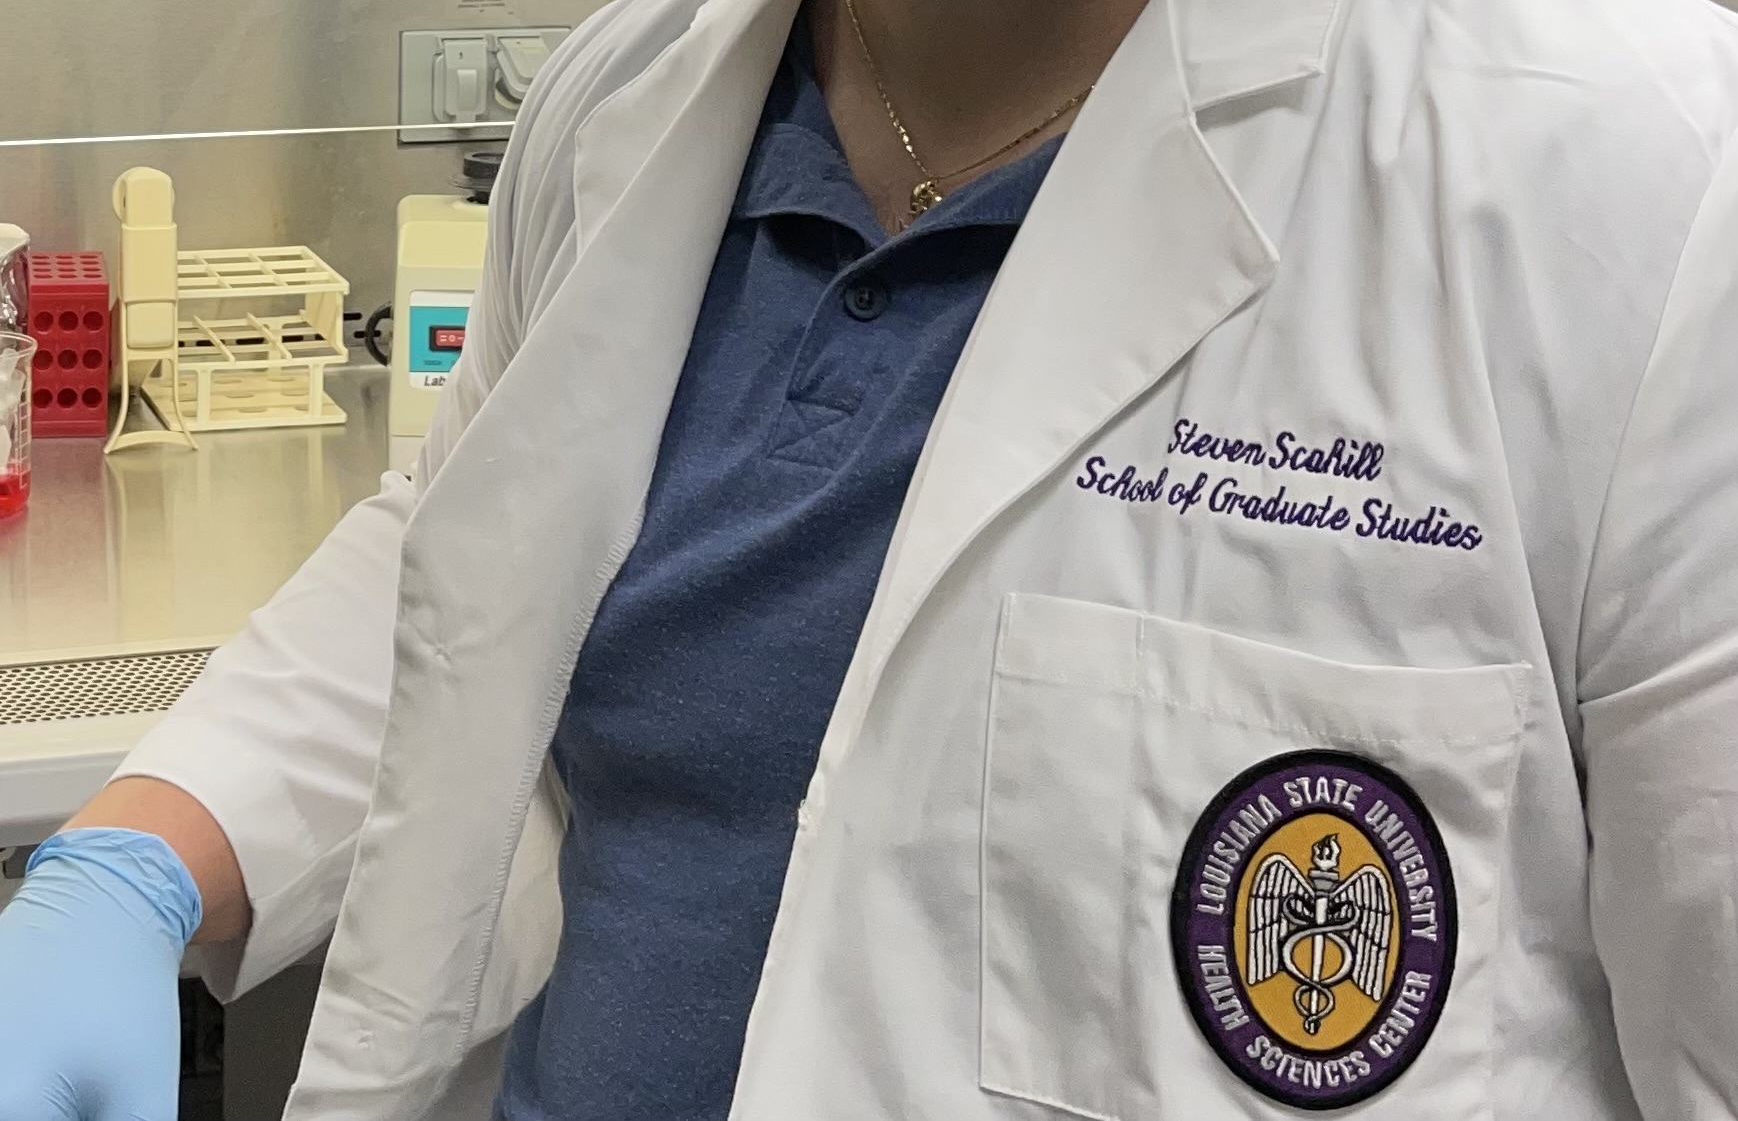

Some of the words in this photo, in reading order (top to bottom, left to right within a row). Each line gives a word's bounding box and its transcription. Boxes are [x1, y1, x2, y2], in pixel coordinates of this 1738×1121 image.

[1076, 456, 1169, 504] School
[1167, 472, 1209, 515] of
[1208, 478, 1351, 532] Graduate
[1355, 497, 1483, 551] Studies
[1167, 418, 1266, 467] Steven
[1267, 431, 1385, 482] Scahill
[1197, 793, 1283, 916] LOUISIANA
[1283, 776, 1363, 811] STATE
[1363, 799, 1437, 942] UNIVERSITY
[1197, 944, 1250, 1031] HEALTH
[1245, 1035, 1372, 1089] SCIENCES
[1369, 969, 1433, 1059] CENTER
